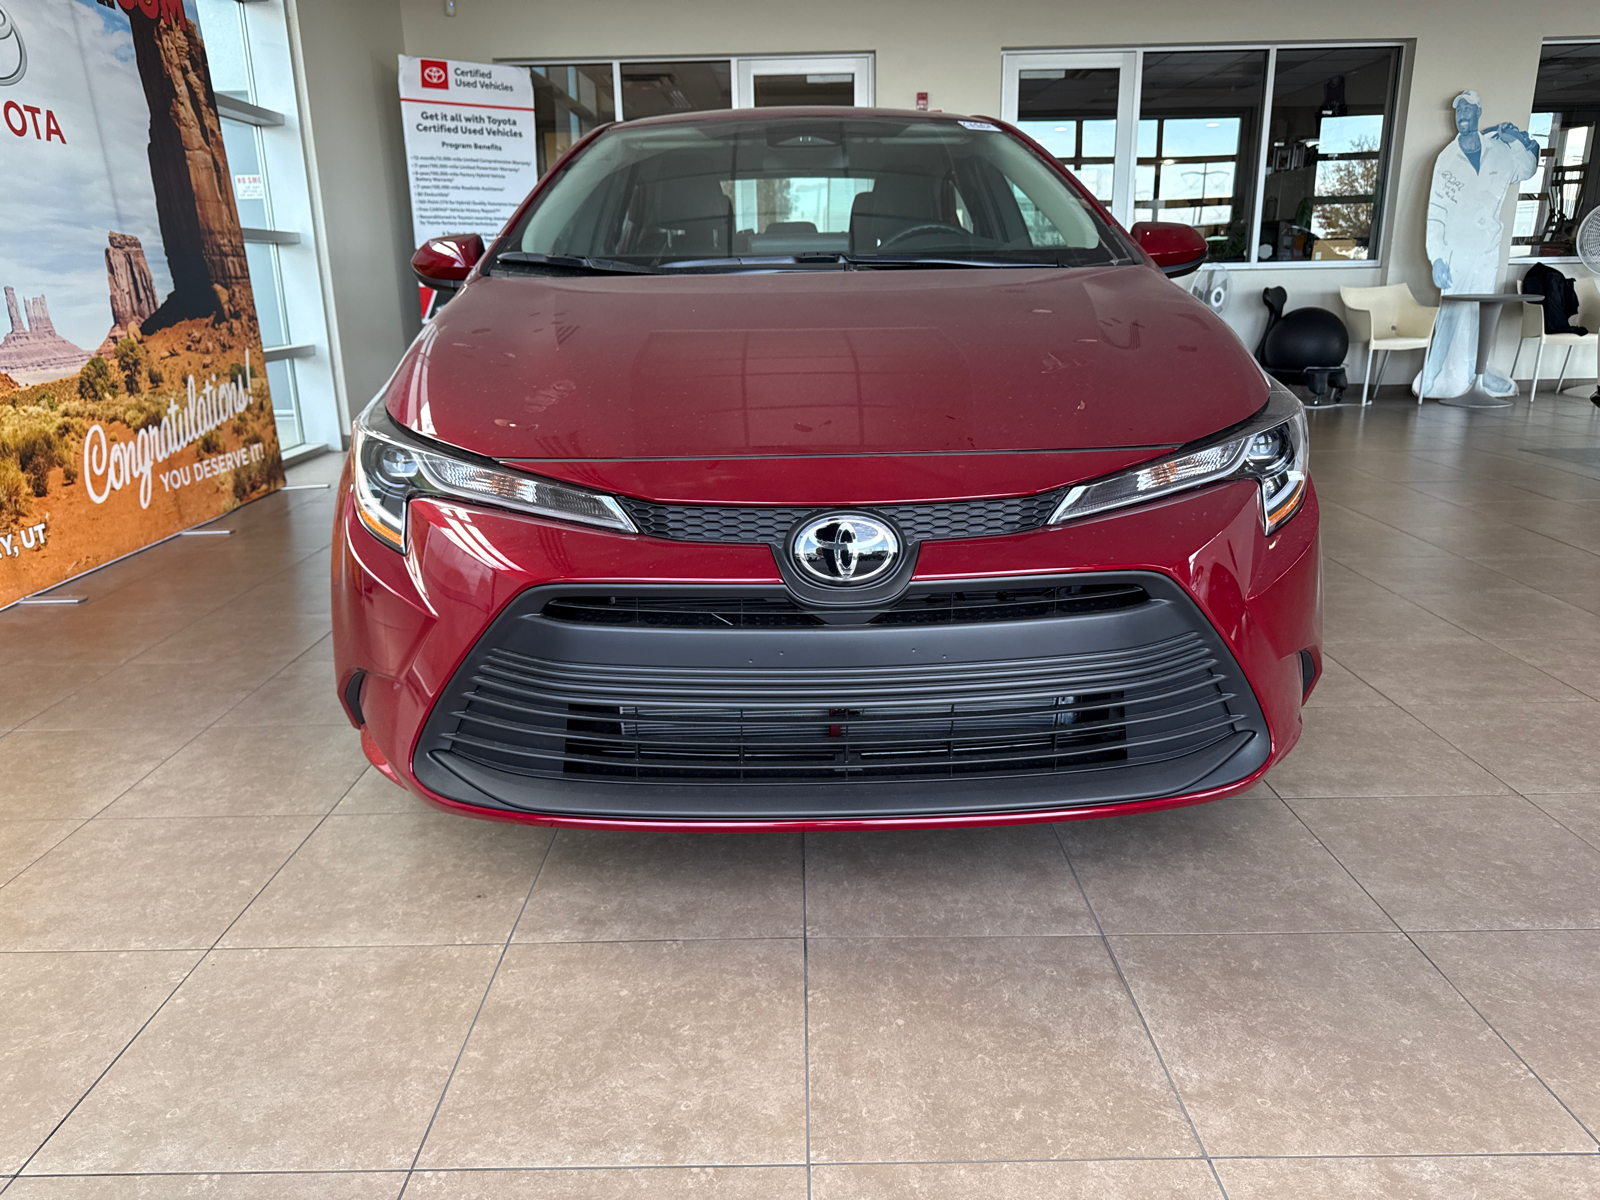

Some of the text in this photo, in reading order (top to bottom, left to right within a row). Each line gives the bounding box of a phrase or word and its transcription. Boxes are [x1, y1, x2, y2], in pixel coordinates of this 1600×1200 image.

[454, 67, 492, 79] Certified
[455, 79, 514, 92] Used Vehicles
[421, 111, 517, 127] Get it all with Toyota
[416, 123, 523, 139] Certified Used Vehicles
[441, 141, 503, 152] Program Benefits
[84, 347, 253, 509] Congratulations!
[159, 442, 266, 492] YOU DESERVE IT!
[0, 523, 46, 558] Y, UT
